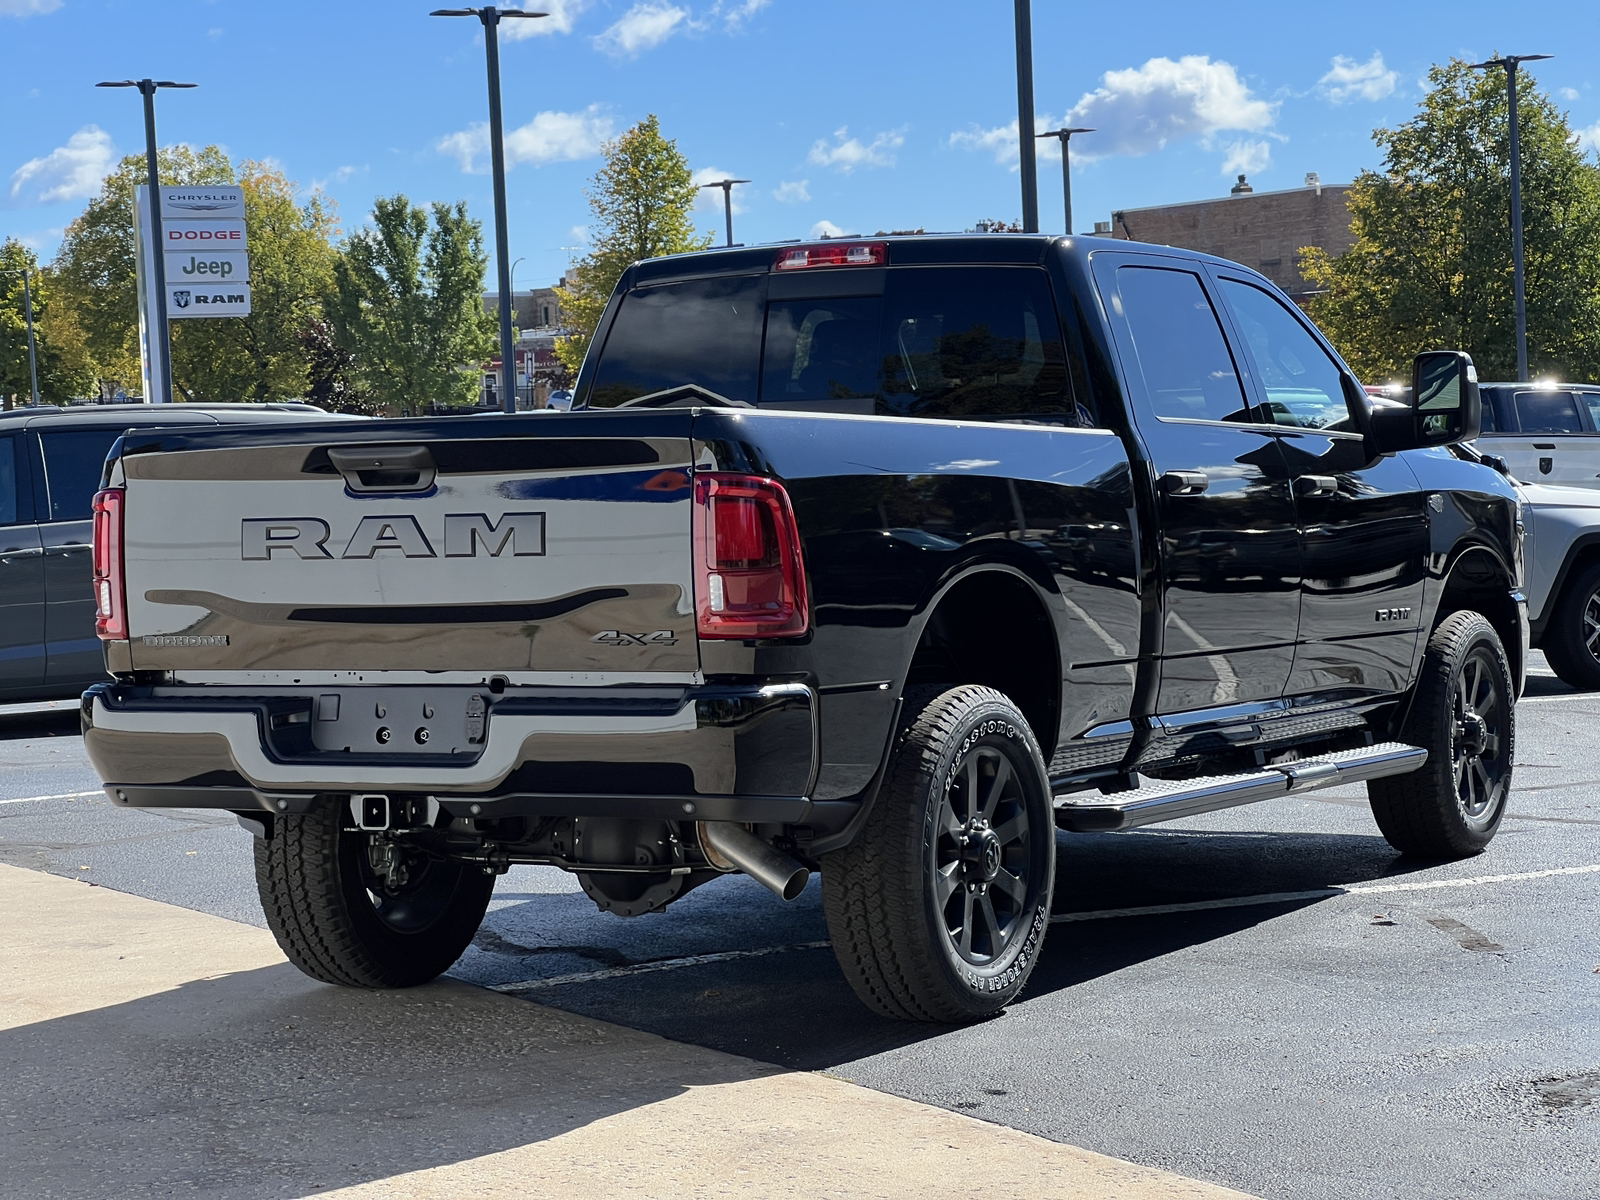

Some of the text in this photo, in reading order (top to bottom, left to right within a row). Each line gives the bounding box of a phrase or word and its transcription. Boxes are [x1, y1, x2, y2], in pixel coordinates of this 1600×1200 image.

[169, 231, 241, 240] DODGE
[182, 256, 233, 278] Jeep
[195, 295, 245, 304] RAM
[241, 511, 547, 561] RAM
[1375, 607, 1411, 621] RAM
[988, 905, 1046, 991] TRANSFORCE
